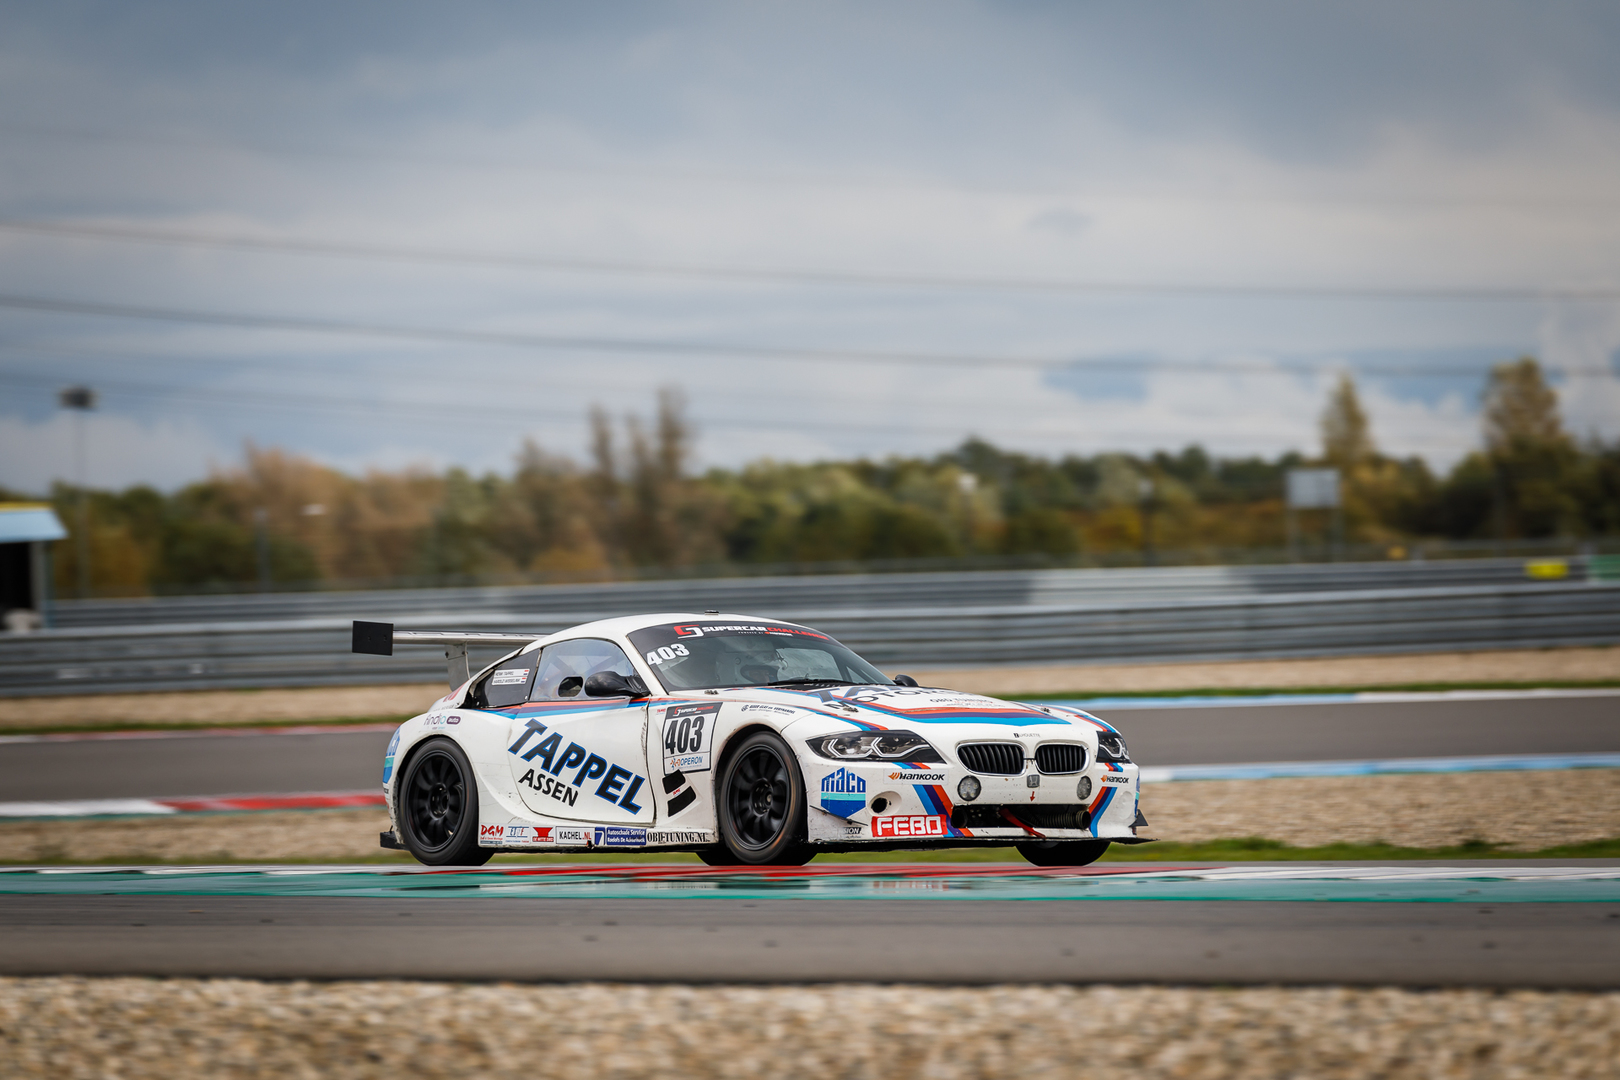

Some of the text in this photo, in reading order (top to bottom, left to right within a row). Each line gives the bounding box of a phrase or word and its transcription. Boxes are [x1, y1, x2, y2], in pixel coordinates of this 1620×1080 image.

[647, 643, 690, 666] 403
[665, 716, 705, 754] 403
[508, 718, 646, 816] TAPPEL
[518, 768, 579, 808] ASSEN
[480, 824, 504, 837] DGM
[559, 831, 592, 840] KACHEL.NL
[876, 815, 943, 836] FEBO
